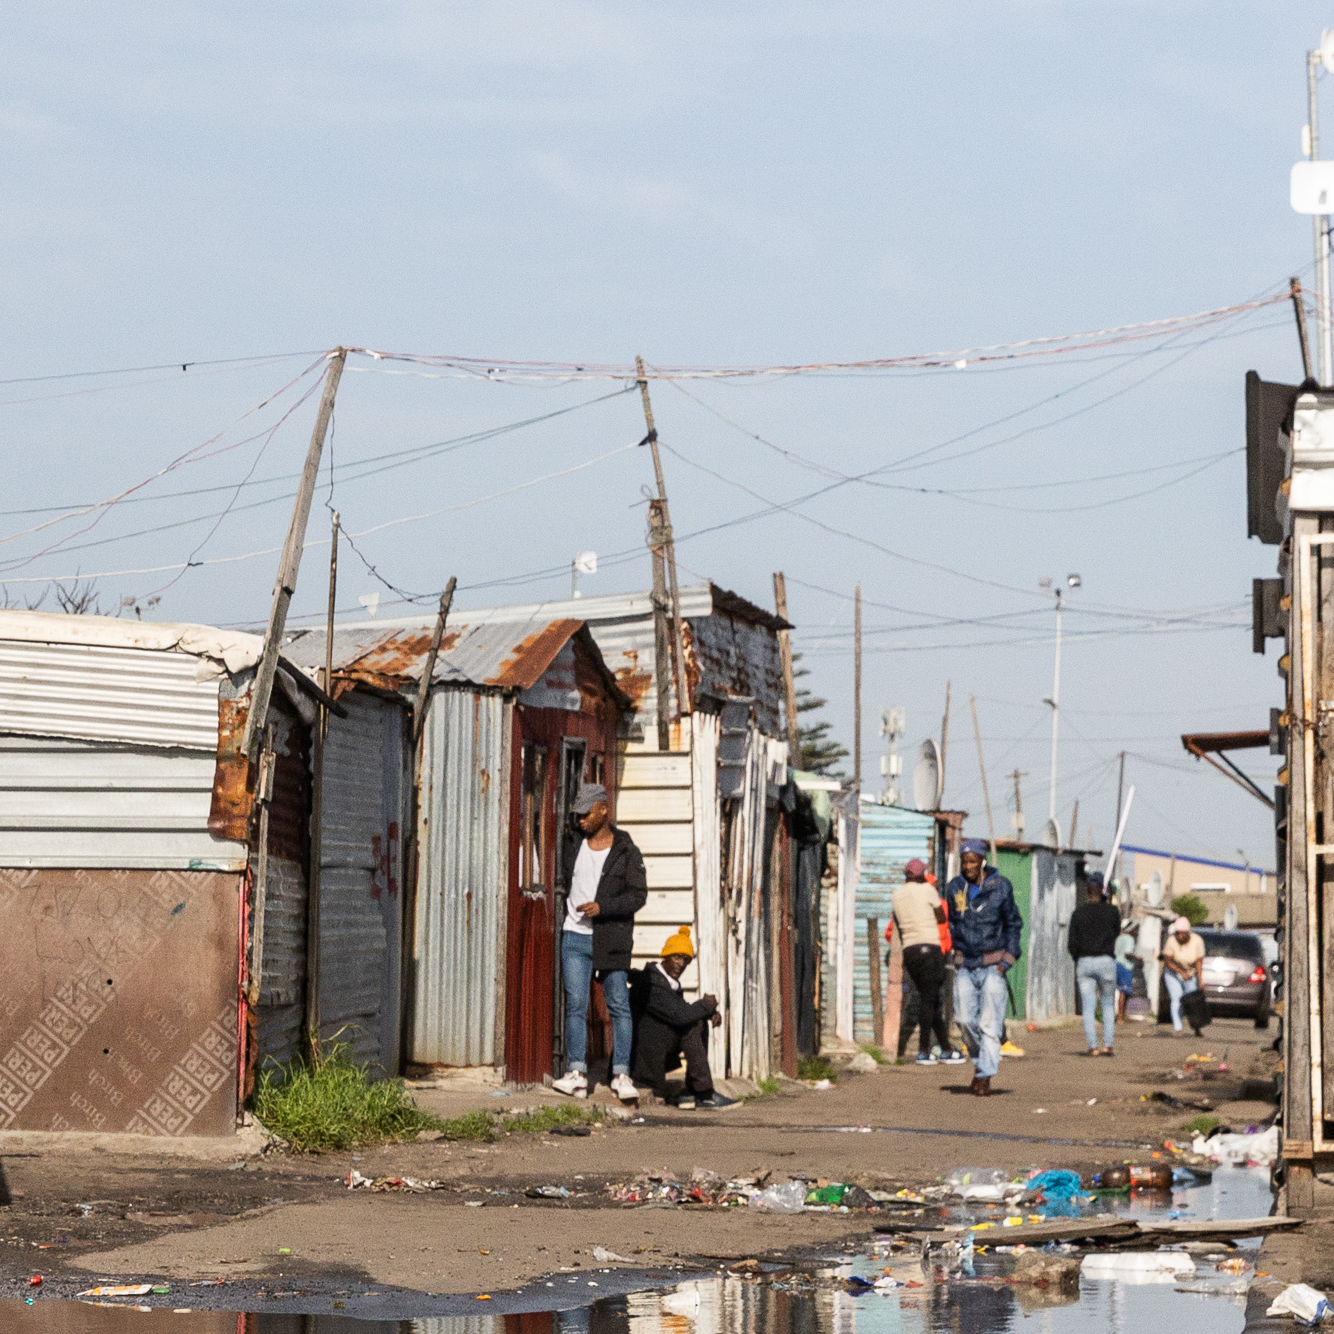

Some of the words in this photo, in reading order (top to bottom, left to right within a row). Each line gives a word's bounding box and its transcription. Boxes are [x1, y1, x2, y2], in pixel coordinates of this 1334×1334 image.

[19, 1024, 61, 1064] PERI
[1, 1046, 43, 1085] PERI
[178, 1048, 220, 1087] PERI
[84, 1068, 125, 1106] Birch
[160, 1070, 202, 1109] PERI
[65, 1090, 107, 1129] Birch
[141, 1092, 183, 1131] PERI
